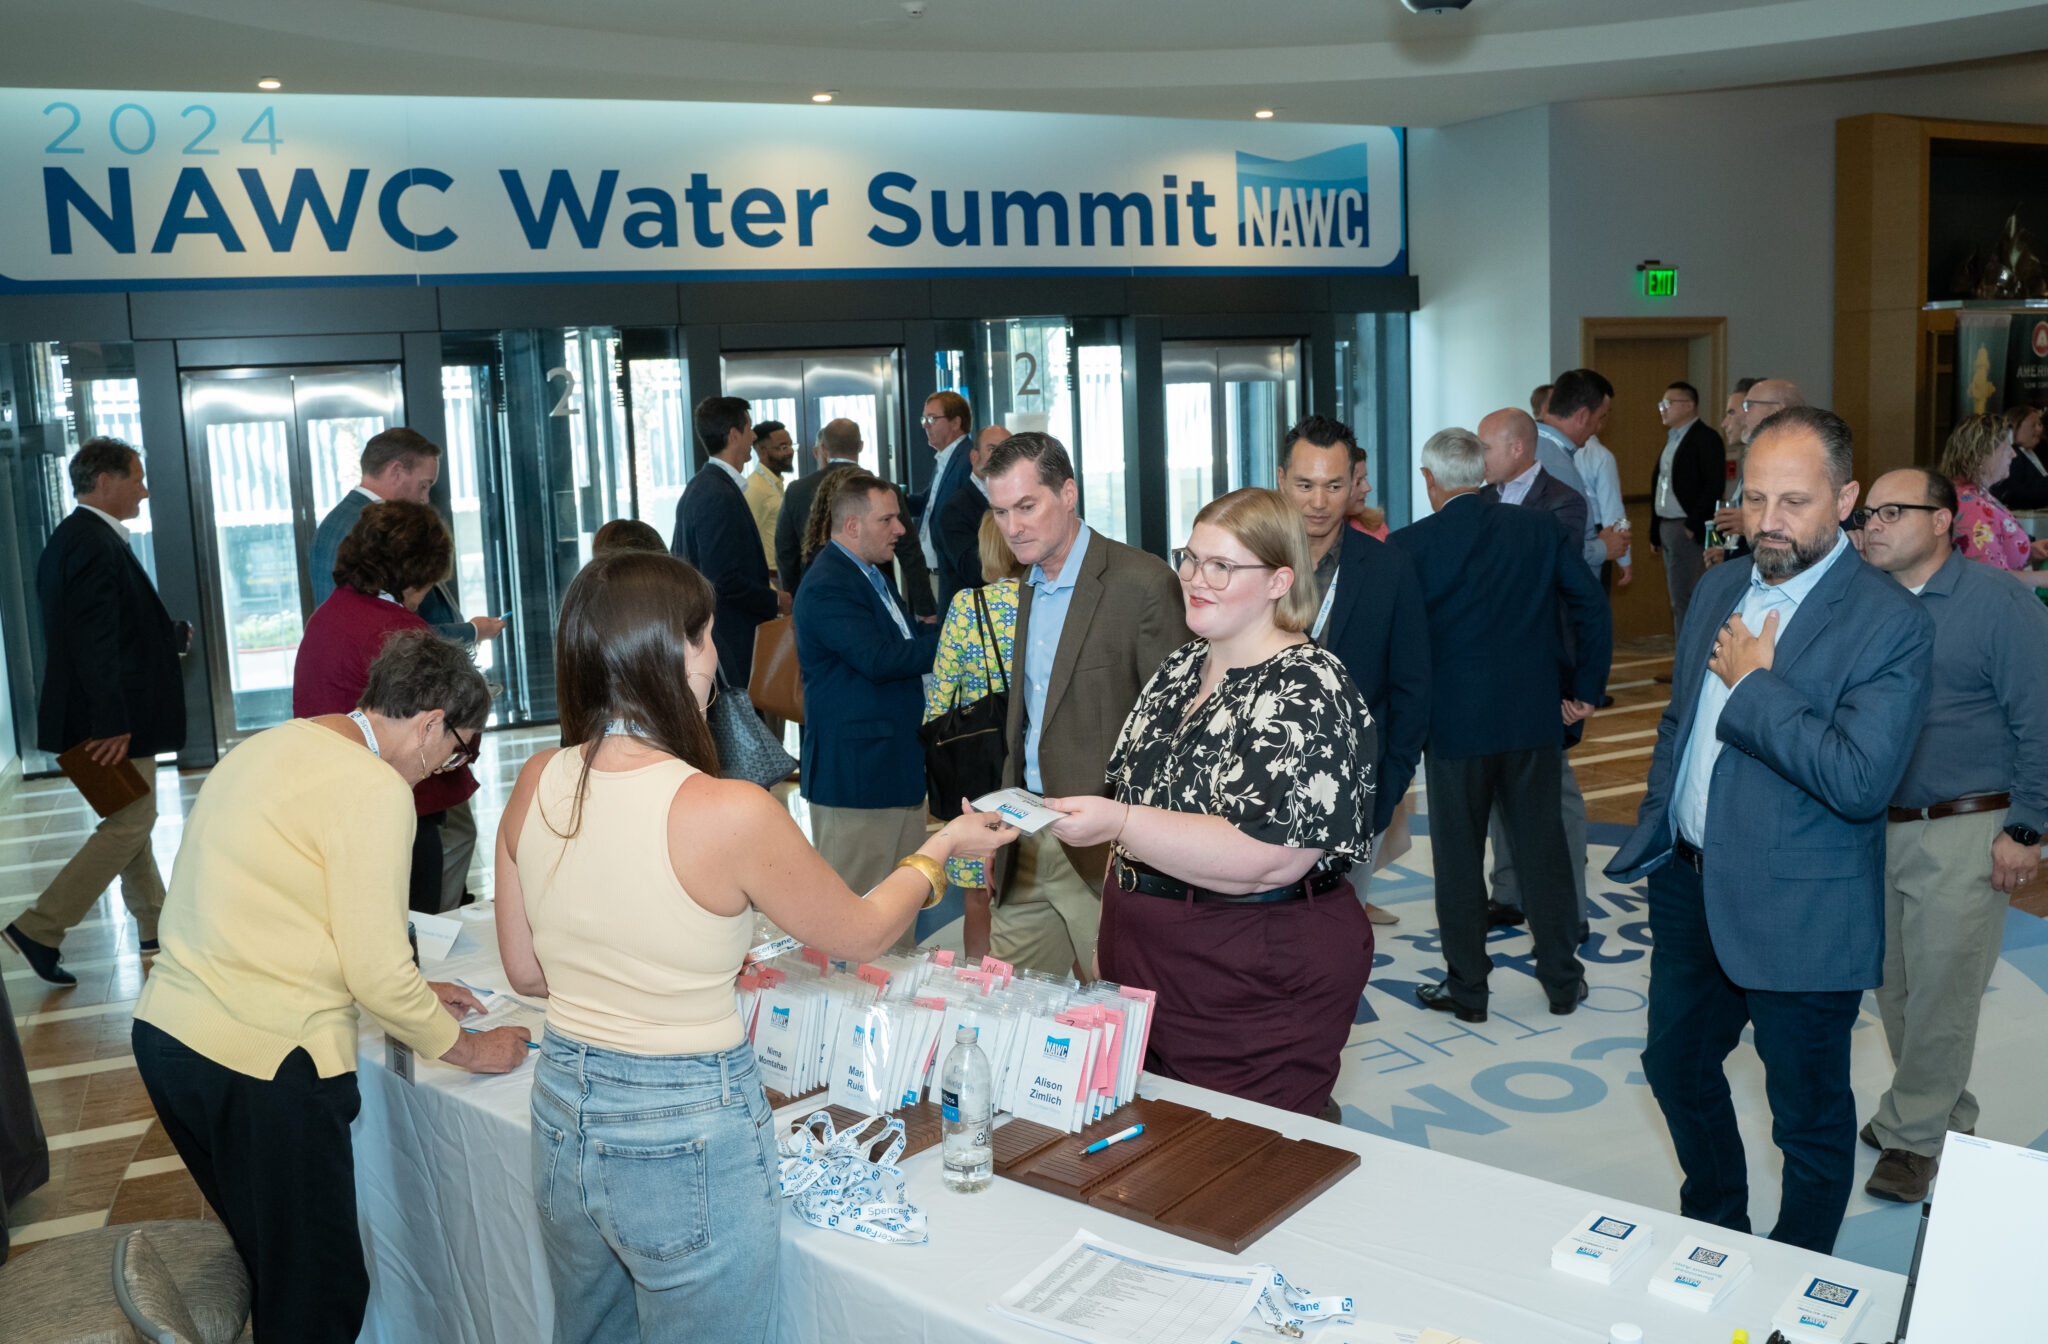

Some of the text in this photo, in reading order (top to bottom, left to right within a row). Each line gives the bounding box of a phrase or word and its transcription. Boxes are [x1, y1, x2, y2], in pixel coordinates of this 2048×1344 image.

[43, 102, 284, 155] 2024
[43, 167, 1218, 254] NAWC Water Summit
[1243, 186, 1364, 249] NAWC
[1649, 270, 1674, 296] EXIT
[1015, 351, 1041, 396] 2
[2016, 365, 2048, 379] AMERI
[546, 366, 581, 417] 2
[767, 1046, 782, 1058] Nima
[1044, 1041, 1068, 1058] NAWC
[758, 1054, 788, 1072] Momtahan
[1034, 1076, 1063, 1092] Alison
[1029, 1088, 1062, 1106] Zimlich
